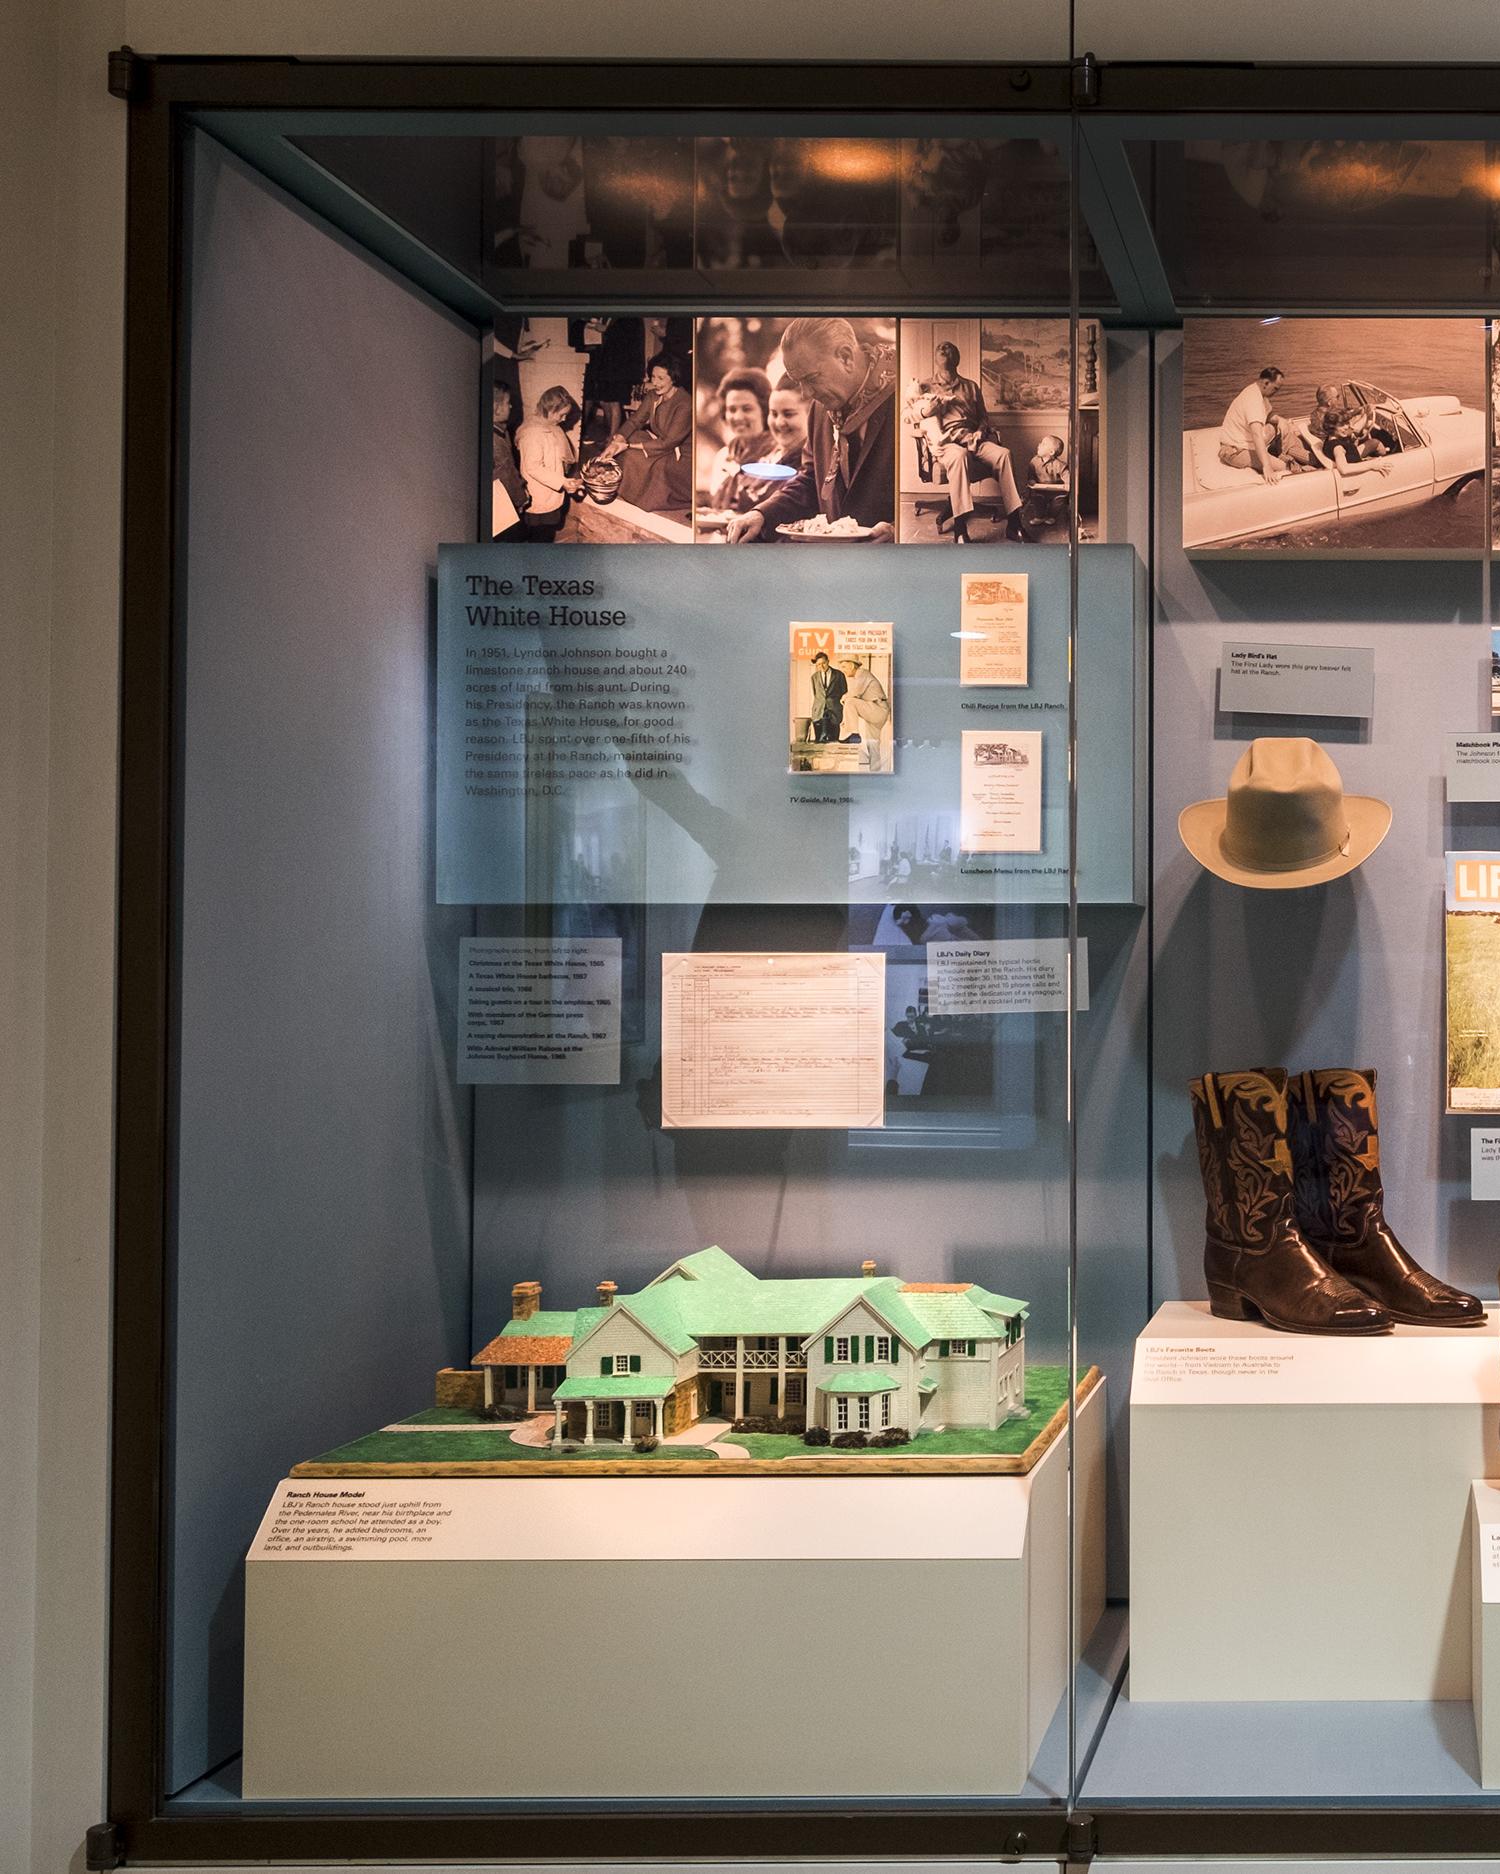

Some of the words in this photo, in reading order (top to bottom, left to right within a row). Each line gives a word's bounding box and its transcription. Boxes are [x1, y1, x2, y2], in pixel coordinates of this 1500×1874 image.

[466, 576, 513, 595] The
[523, 576, 594, 595] Texas
[466, 606, 539, 625] White
[550, 606, 626, 625] House
[798, 632, 830, 647] TV
[466, 649, 476, 657] In
[482, 649, 509, 658] 1951,
[514, 649, 556, 660] Lyndon
[560, 649, 611, 658] Johnson
[616, 649, 656, 660] bought
[466, 666, 523, 675] limestone
[528, 666, 560, 675] ranch
[565, 666, 599, 675] house
[604, 666, 625, 675] and
[629, 666, 662, 675] about
[667, 666, 687, 675] 240
[466, 684, 496, 692] acres
[500, 682, 513, 692] of
[517, 682, 540, 692] land
[545, 682, 573, 692] from
[577, 682, 593, 692] his
[598, 683, 626, 692] aunt.
[631, 682, 670, 694] During
[466, 700, 481, 709] his
[487, 700, 552, 711] Presidency,
[556, 700, 574, 709] the
[579, 700, 615, 709] Ranch
[646, 700, 685, 709] known
[978, 703, 998, 711] Recipe
[482, 717, 499, 726] the
[504, 717, 537, 726] Texas
[541, 717, 575, 726] White
[580, 717, 619, 728] House,
[624, 717, 639, 726] for
[644, 717, 673, 729] good
[466, 752, 528, 763] Presidency
[548, 752, 566, 760] the
[570, 752, 608, 762] Ranch,
[614, 752, 682, 763] maintaining
[465, 786, 537, 798] Washington,
[396, 1510, 434, 1518] birthplace
[306, 1536, 336, 1544] airstrip,
[346, 1536, 387, 1544] swimming
[302, 1544, 354, 1552] outbuildings.
